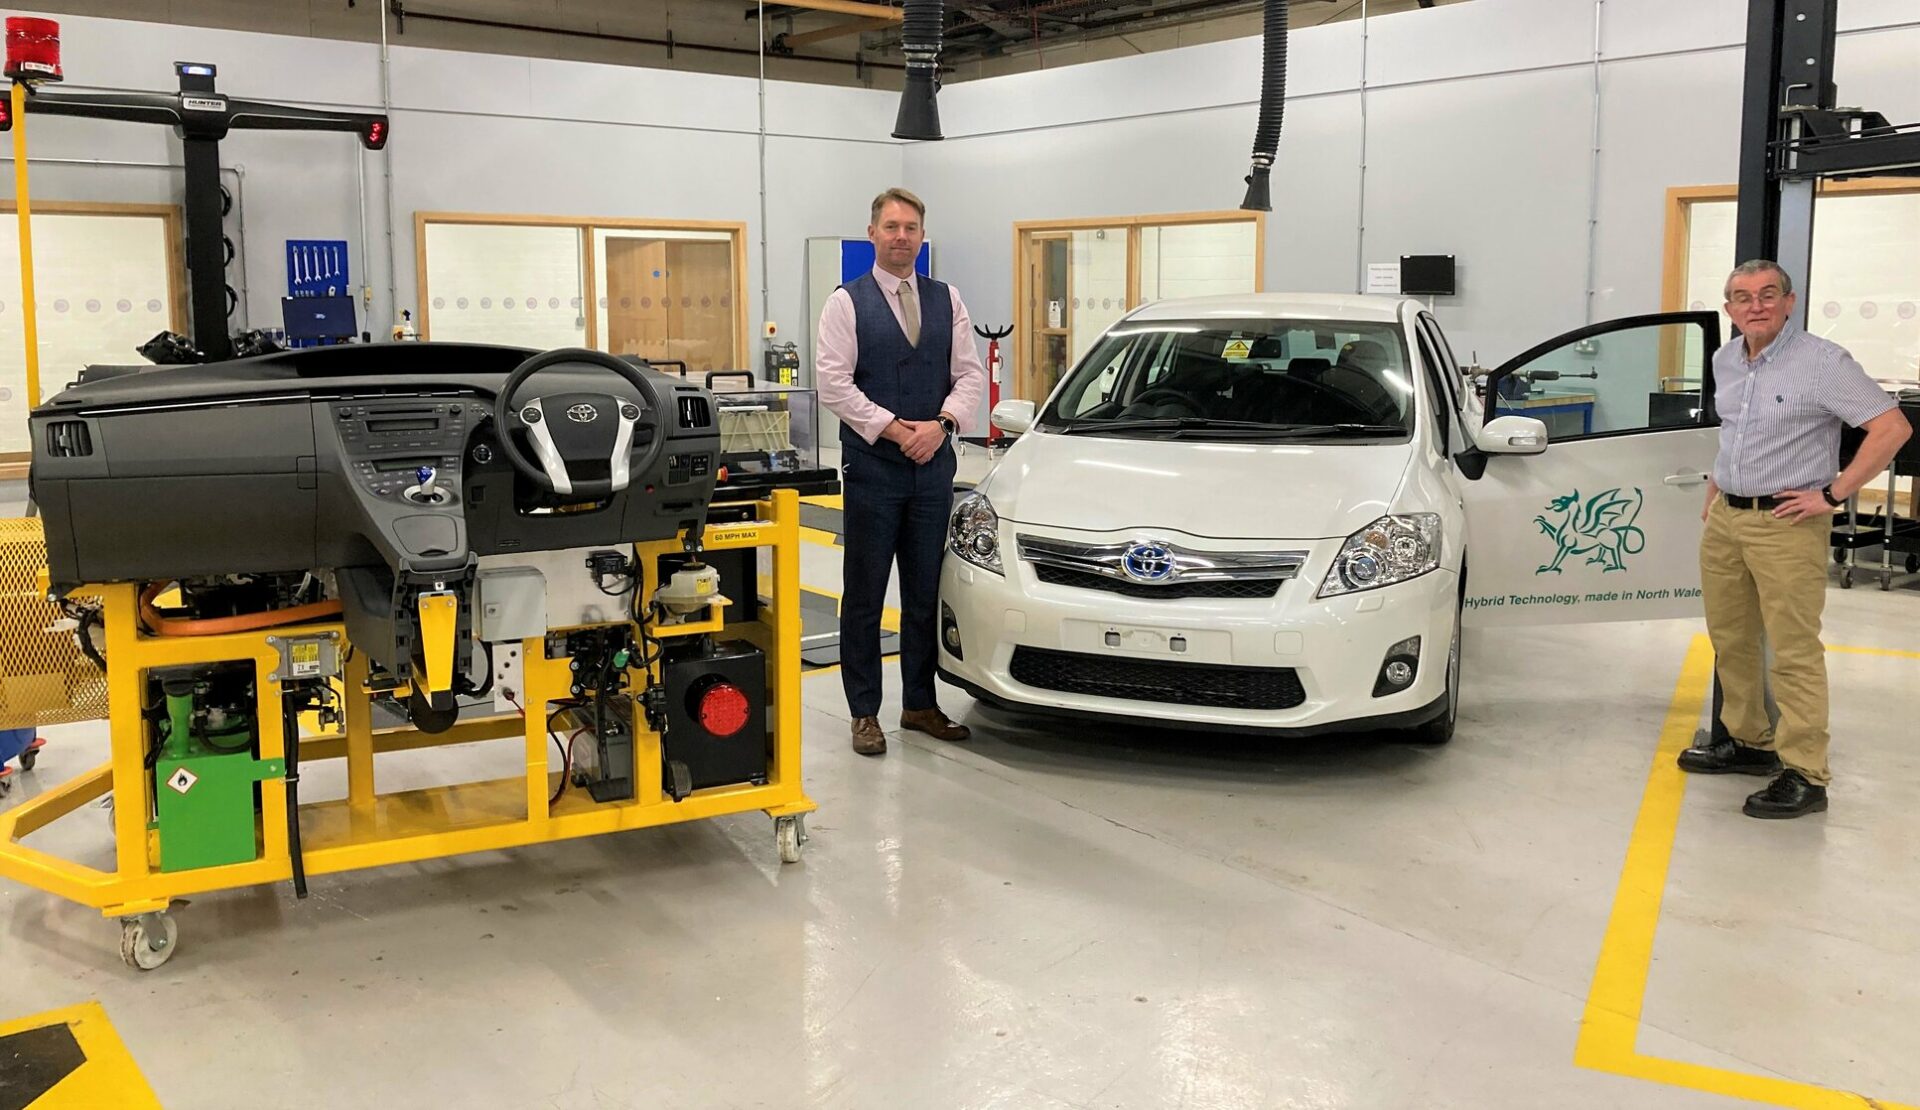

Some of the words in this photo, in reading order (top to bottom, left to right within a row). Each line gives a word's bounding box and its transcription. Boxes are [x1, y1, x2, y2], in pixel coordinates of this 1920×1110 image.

[1464, 595, 1505, 610] Hybrid
[1509, 593, 1580, 605] Technology,
[1584, 591, 1618, 602] made
[1621, 590, 1633, 600] in
[1636, 589, 1670, 599] North
[1673, 587, 1704, 598] Wale
